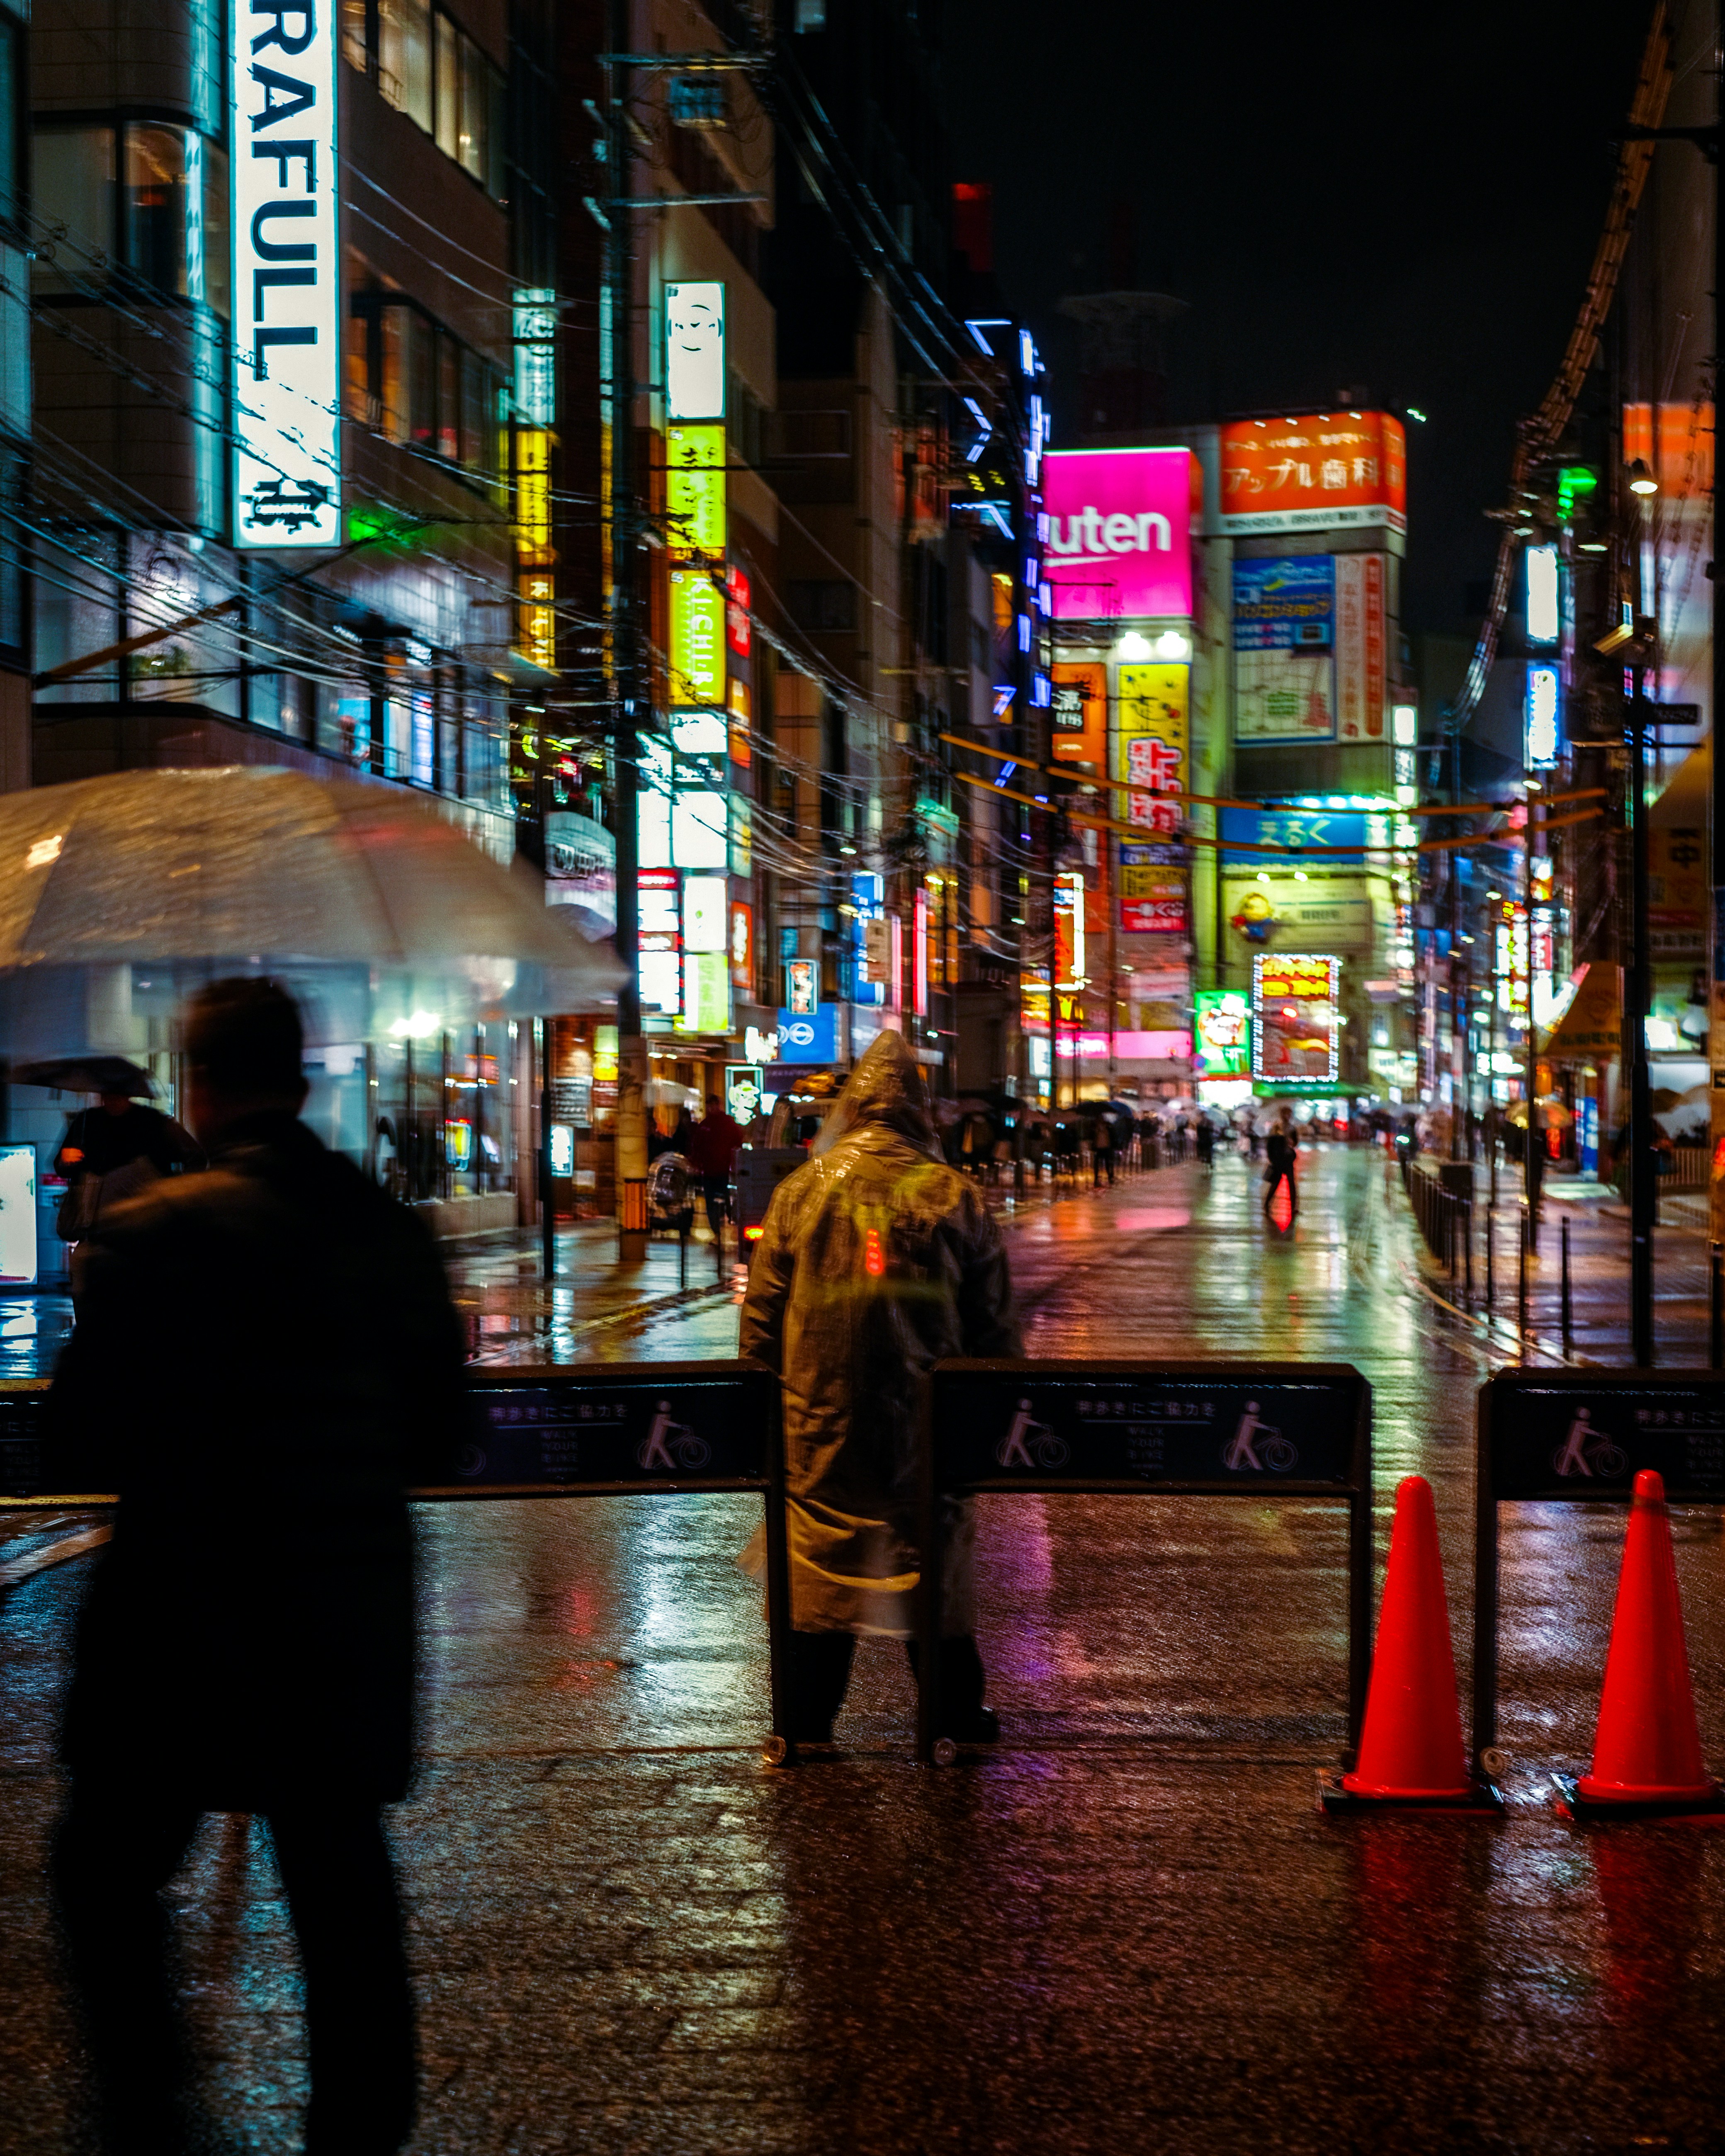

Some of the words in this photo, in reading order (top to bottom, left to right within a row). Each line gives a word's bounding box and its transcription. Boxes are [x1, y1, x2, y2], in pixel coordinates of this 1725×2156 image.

[251, 0, 318, 382] RAFULL
[1223, 458, 1379, 493] アップル歯科
